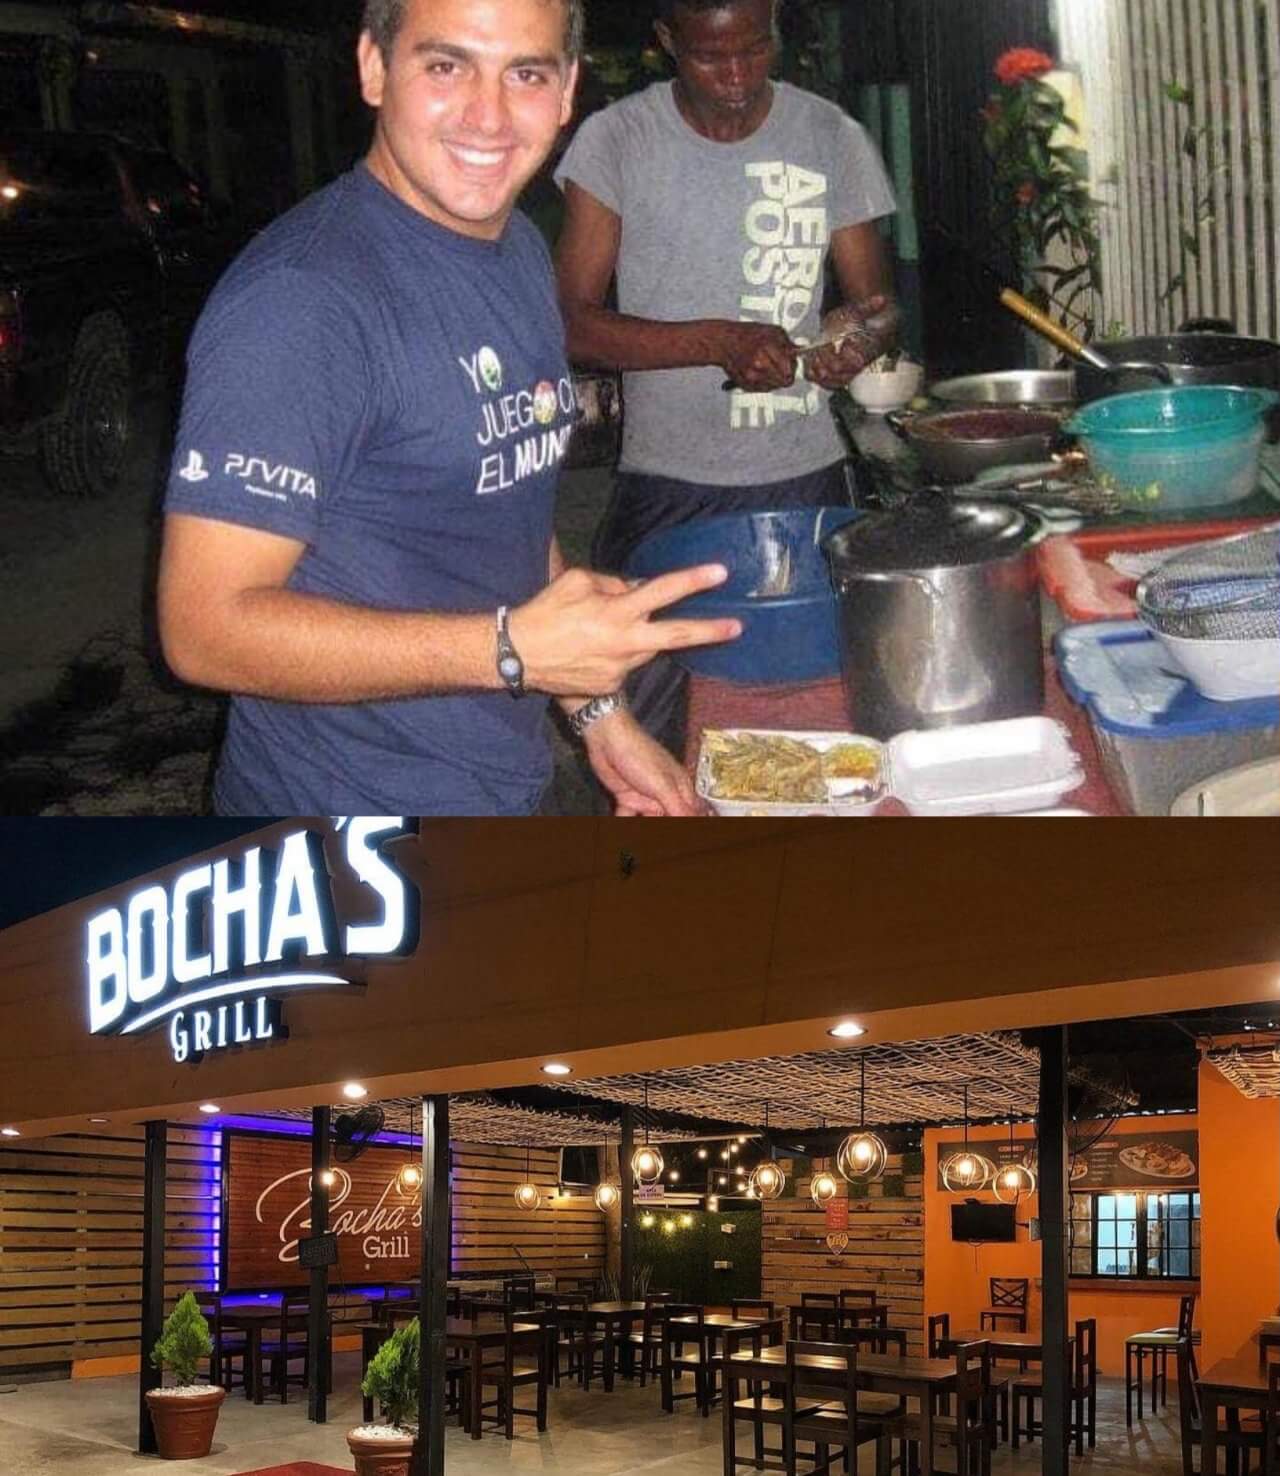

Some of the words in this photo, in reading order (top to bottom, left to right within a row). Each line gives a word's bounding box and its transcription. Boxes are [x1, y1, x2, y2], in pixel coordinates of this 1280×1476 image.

[730, 160, 786, 430] POSTE
[784, 163, 828, 333] AERO
[476, 452, 514, 494] EL
[514, 424, 572, 481] MUN
[87, 816, 406, 1035] BOCHA'S
[170, 996, 274, 1063] GRILL
[362, 1235, 410, 1258] Grill
